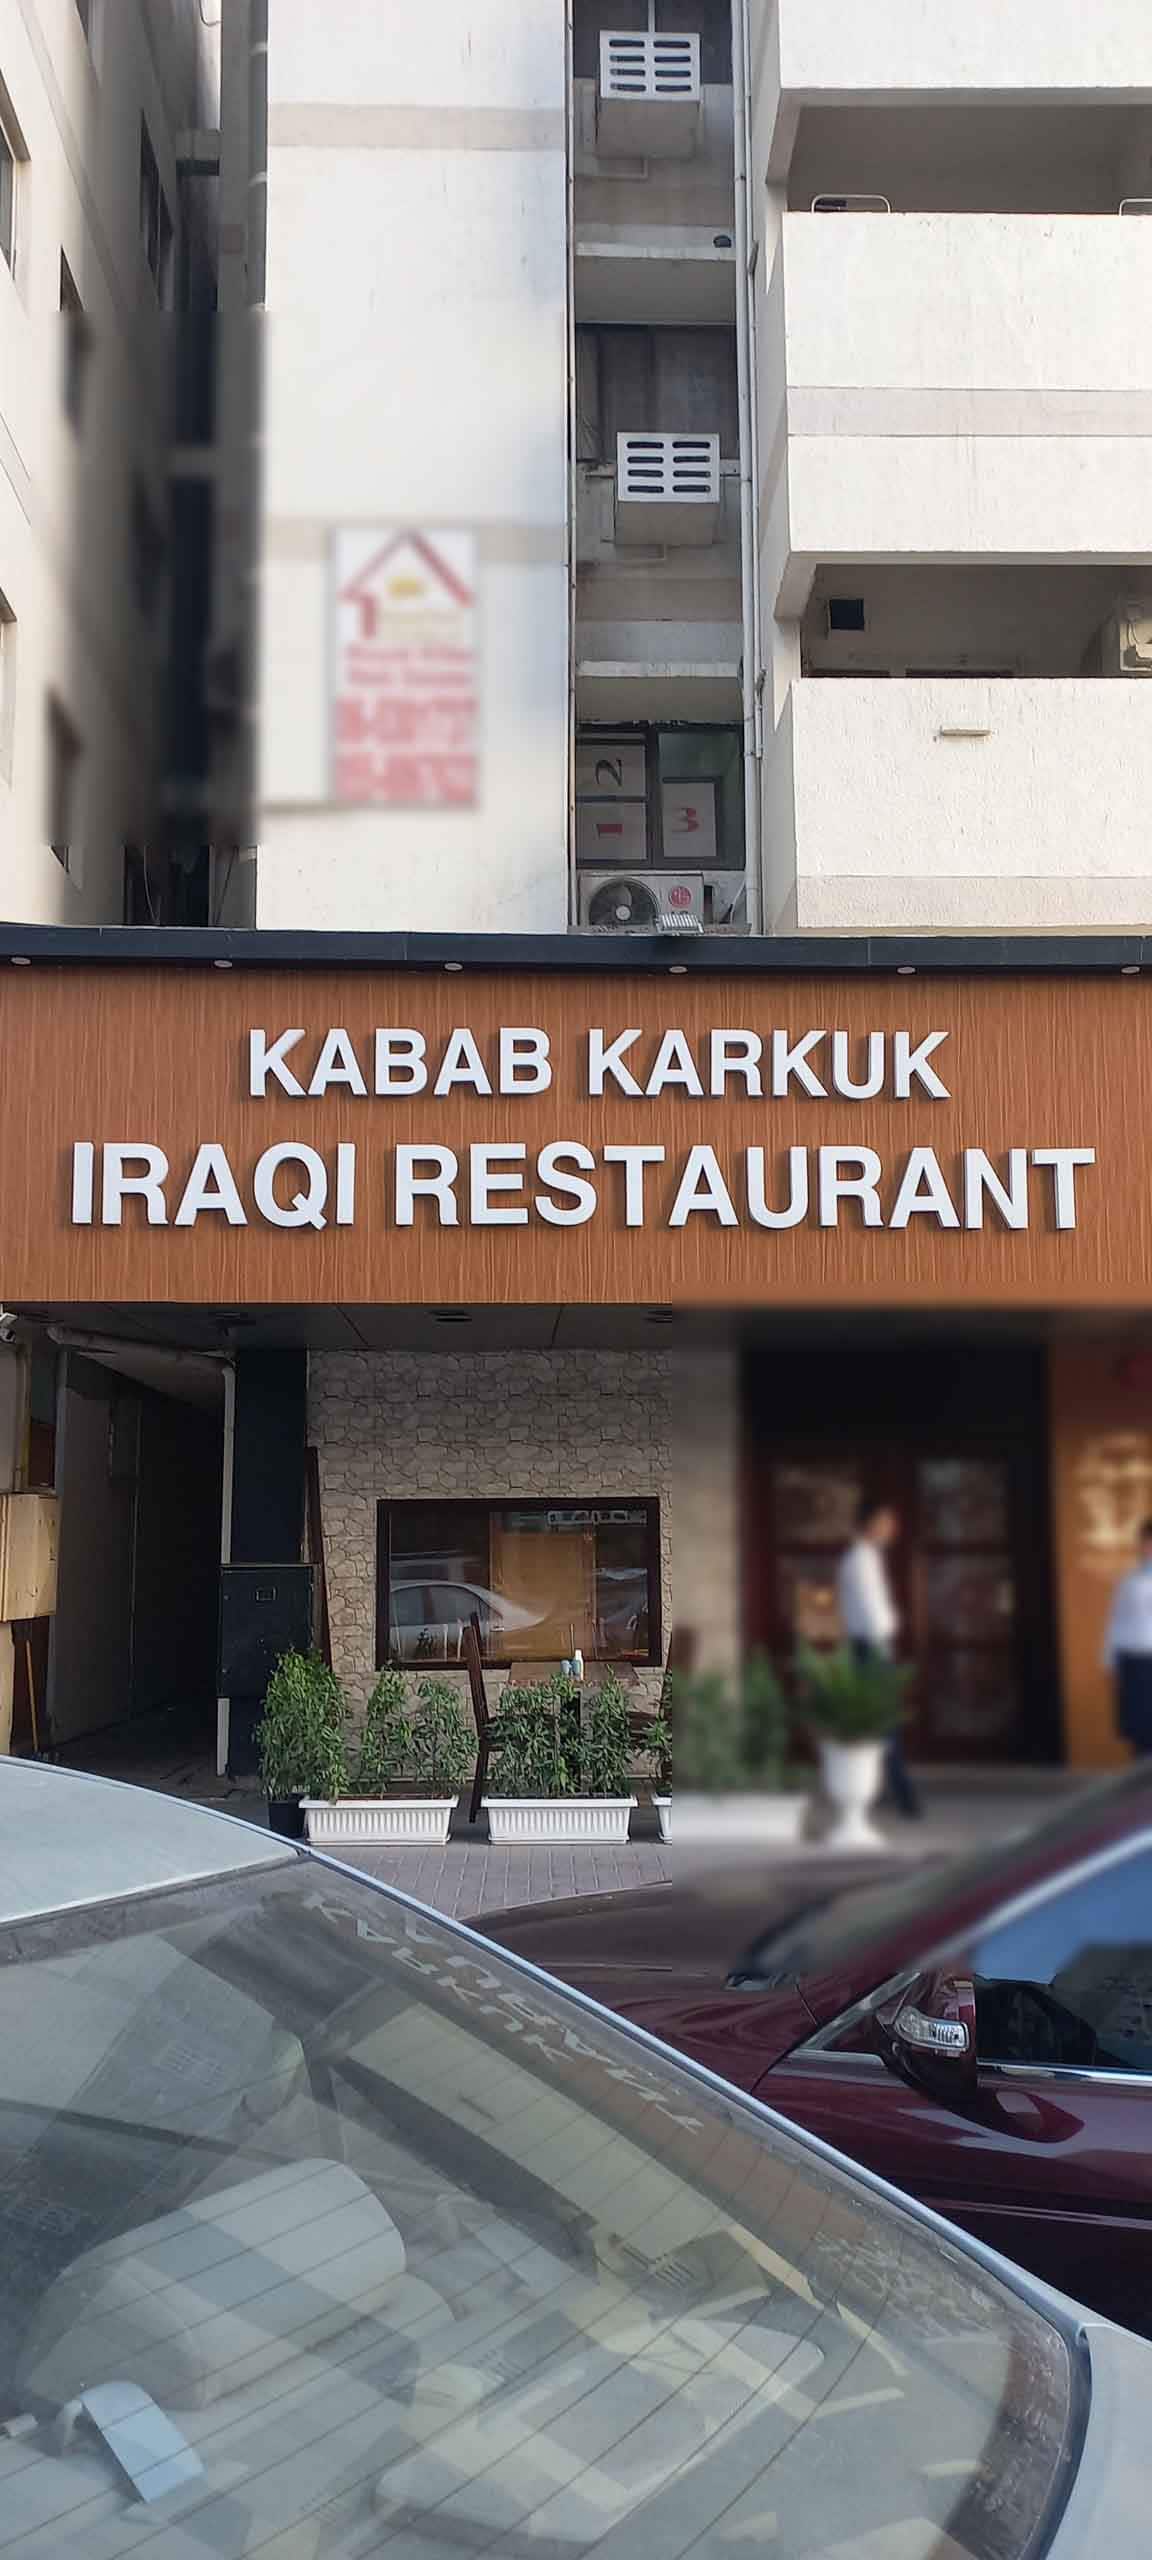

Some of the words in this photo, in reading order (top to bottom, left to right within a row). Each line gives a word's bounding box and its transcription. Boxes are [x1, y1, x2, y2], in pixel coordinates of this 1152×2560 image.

[595, 758, 623, 787] 2
[249, 1027, 553, 1098] KABAB
[588, 1028, 952, 1100] KARKUK
[71, 1140, 357, 1231] IRAQI
[394, 1140, 1097, 1230] RESTAURANT
